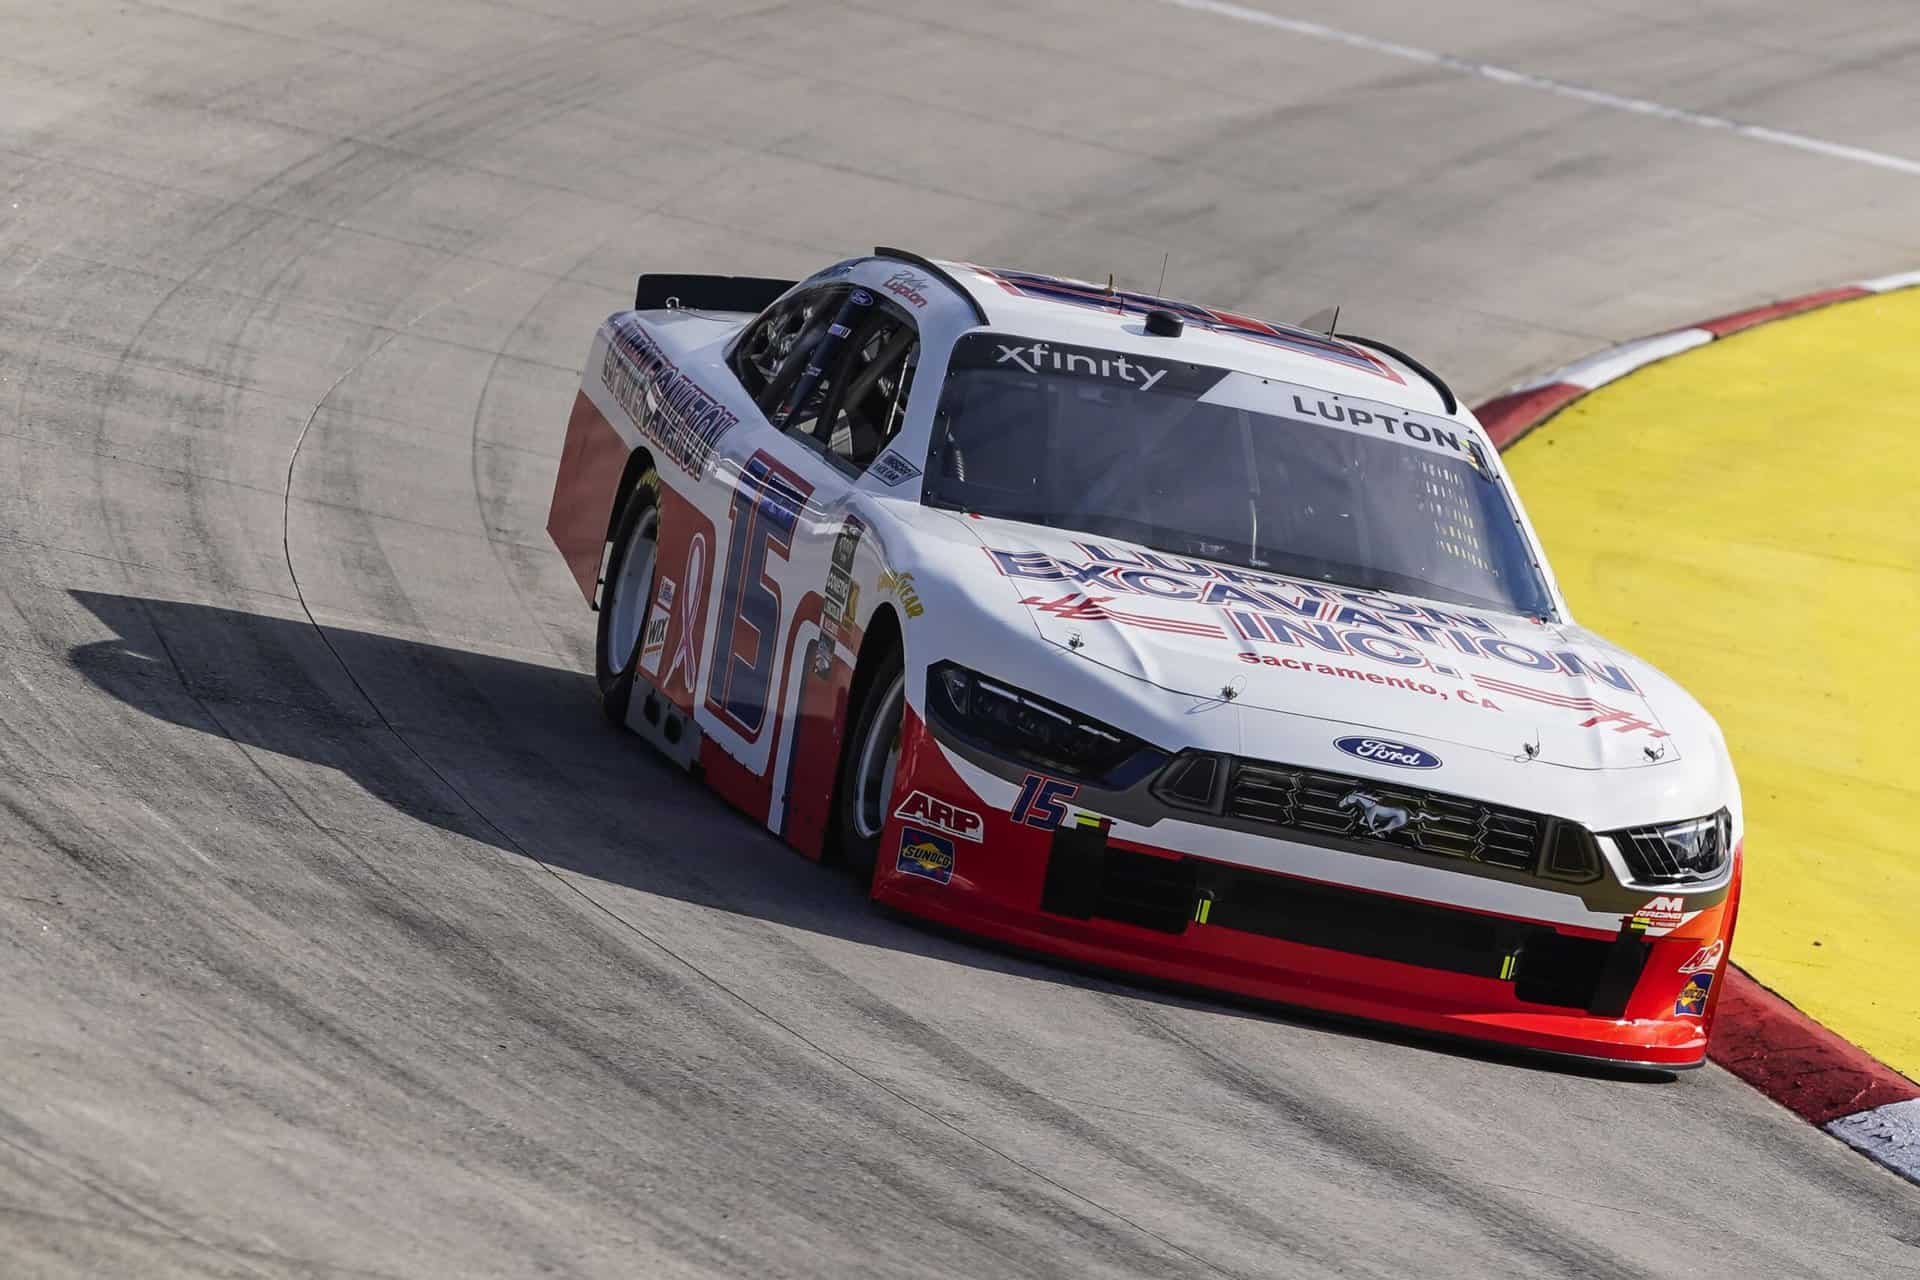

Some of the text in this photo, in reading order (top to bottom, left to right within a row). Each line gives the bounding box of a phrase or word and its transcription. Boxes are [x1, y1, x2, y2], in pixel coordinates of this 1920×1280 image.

[997, 342, 1167, 391] xfinity
[1293, 395, 1460, 451] LUPTON
[705, 448, 815, 744] 15
[1072, 541, 1505, 638] LUPTON
[647, 616, 669, 645] WIX
[981, 547, 1645, 697] EXCAVATION
[1223, 608, 1462, 679] INC.
[1238, 652, 1504, 712] Sacramento, CA
[1356, 739, 1420, 765] Ford
[896, 791, 983, 838] ARP
[1010, 770, 1080, 831] 15
[903, 846, 950, 867] SUNOCO
